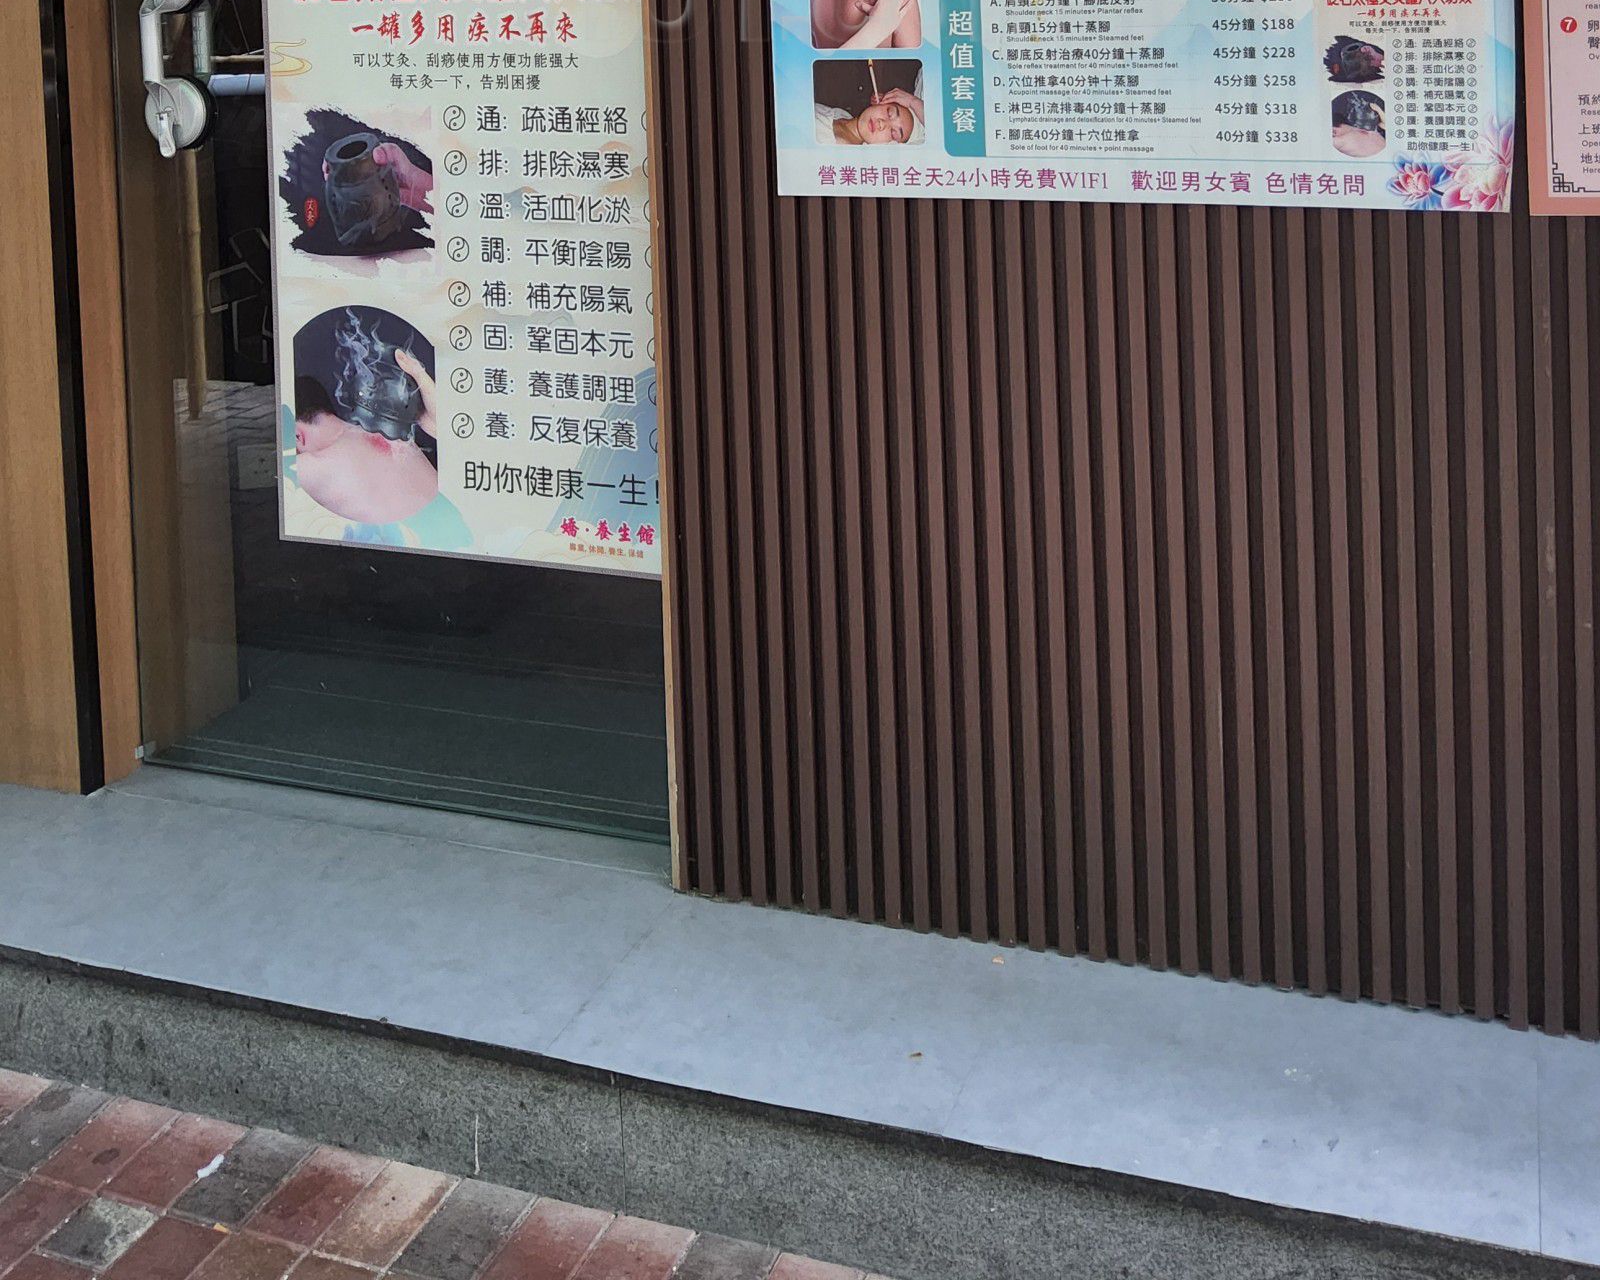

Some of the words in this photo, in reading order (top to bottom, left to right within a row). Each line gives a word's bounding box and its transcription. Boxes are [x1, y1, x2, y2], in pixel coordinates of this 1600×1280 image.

[1262, 17, 1295, 31] $188
[1213, 46, 1257, 59] 45分鐘
[1263, 46, 1296, 59] $228
[948, 11, 977, 134] 超值套餐
[1264, 74, 1296, 87] $258
[1265, 101, 1298, 115] $318
[521, 106, 628, 135] 疏通經絡
[1266, 129, 1298, 143] $338
[1131, 169, 1251, 193] 歡迎男女賓
[1266, 171, 1365, 196] 色情免問
[528, 371, 637, 405] 養護調理
[529, 415, 637, 450] 反復保養
